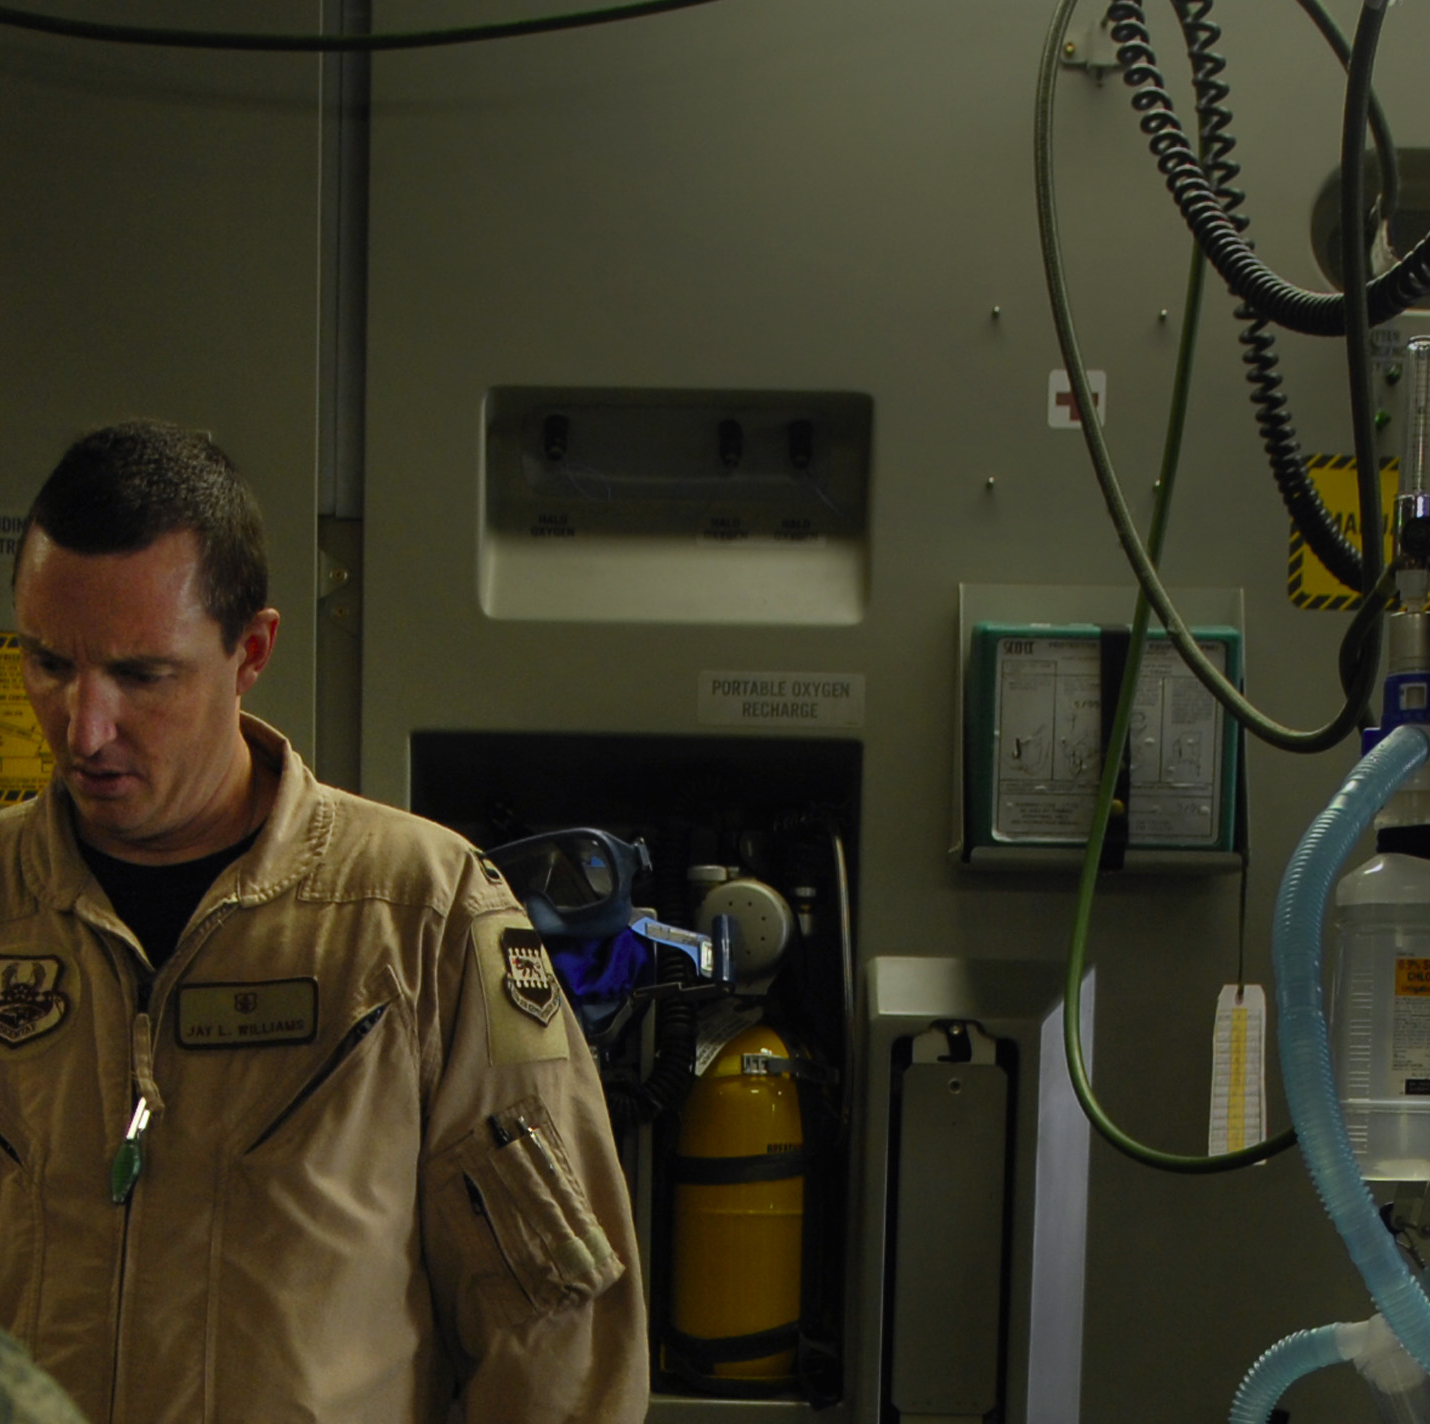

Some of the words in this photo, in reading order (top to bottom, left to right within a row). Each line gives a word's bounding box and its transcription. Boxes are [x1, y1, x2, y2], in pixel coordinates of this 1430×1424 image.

[711, 679, 787, 697] PORTABLE
[791, 680, 851, 698] OXYGEN
[741, 701, 819, 719] RECHARGE
[185, 1023, 214, 1038] JAY
[217, 1023, 233, 1037] L.
[237, 1018, 306, 1037] WILLIAMS
